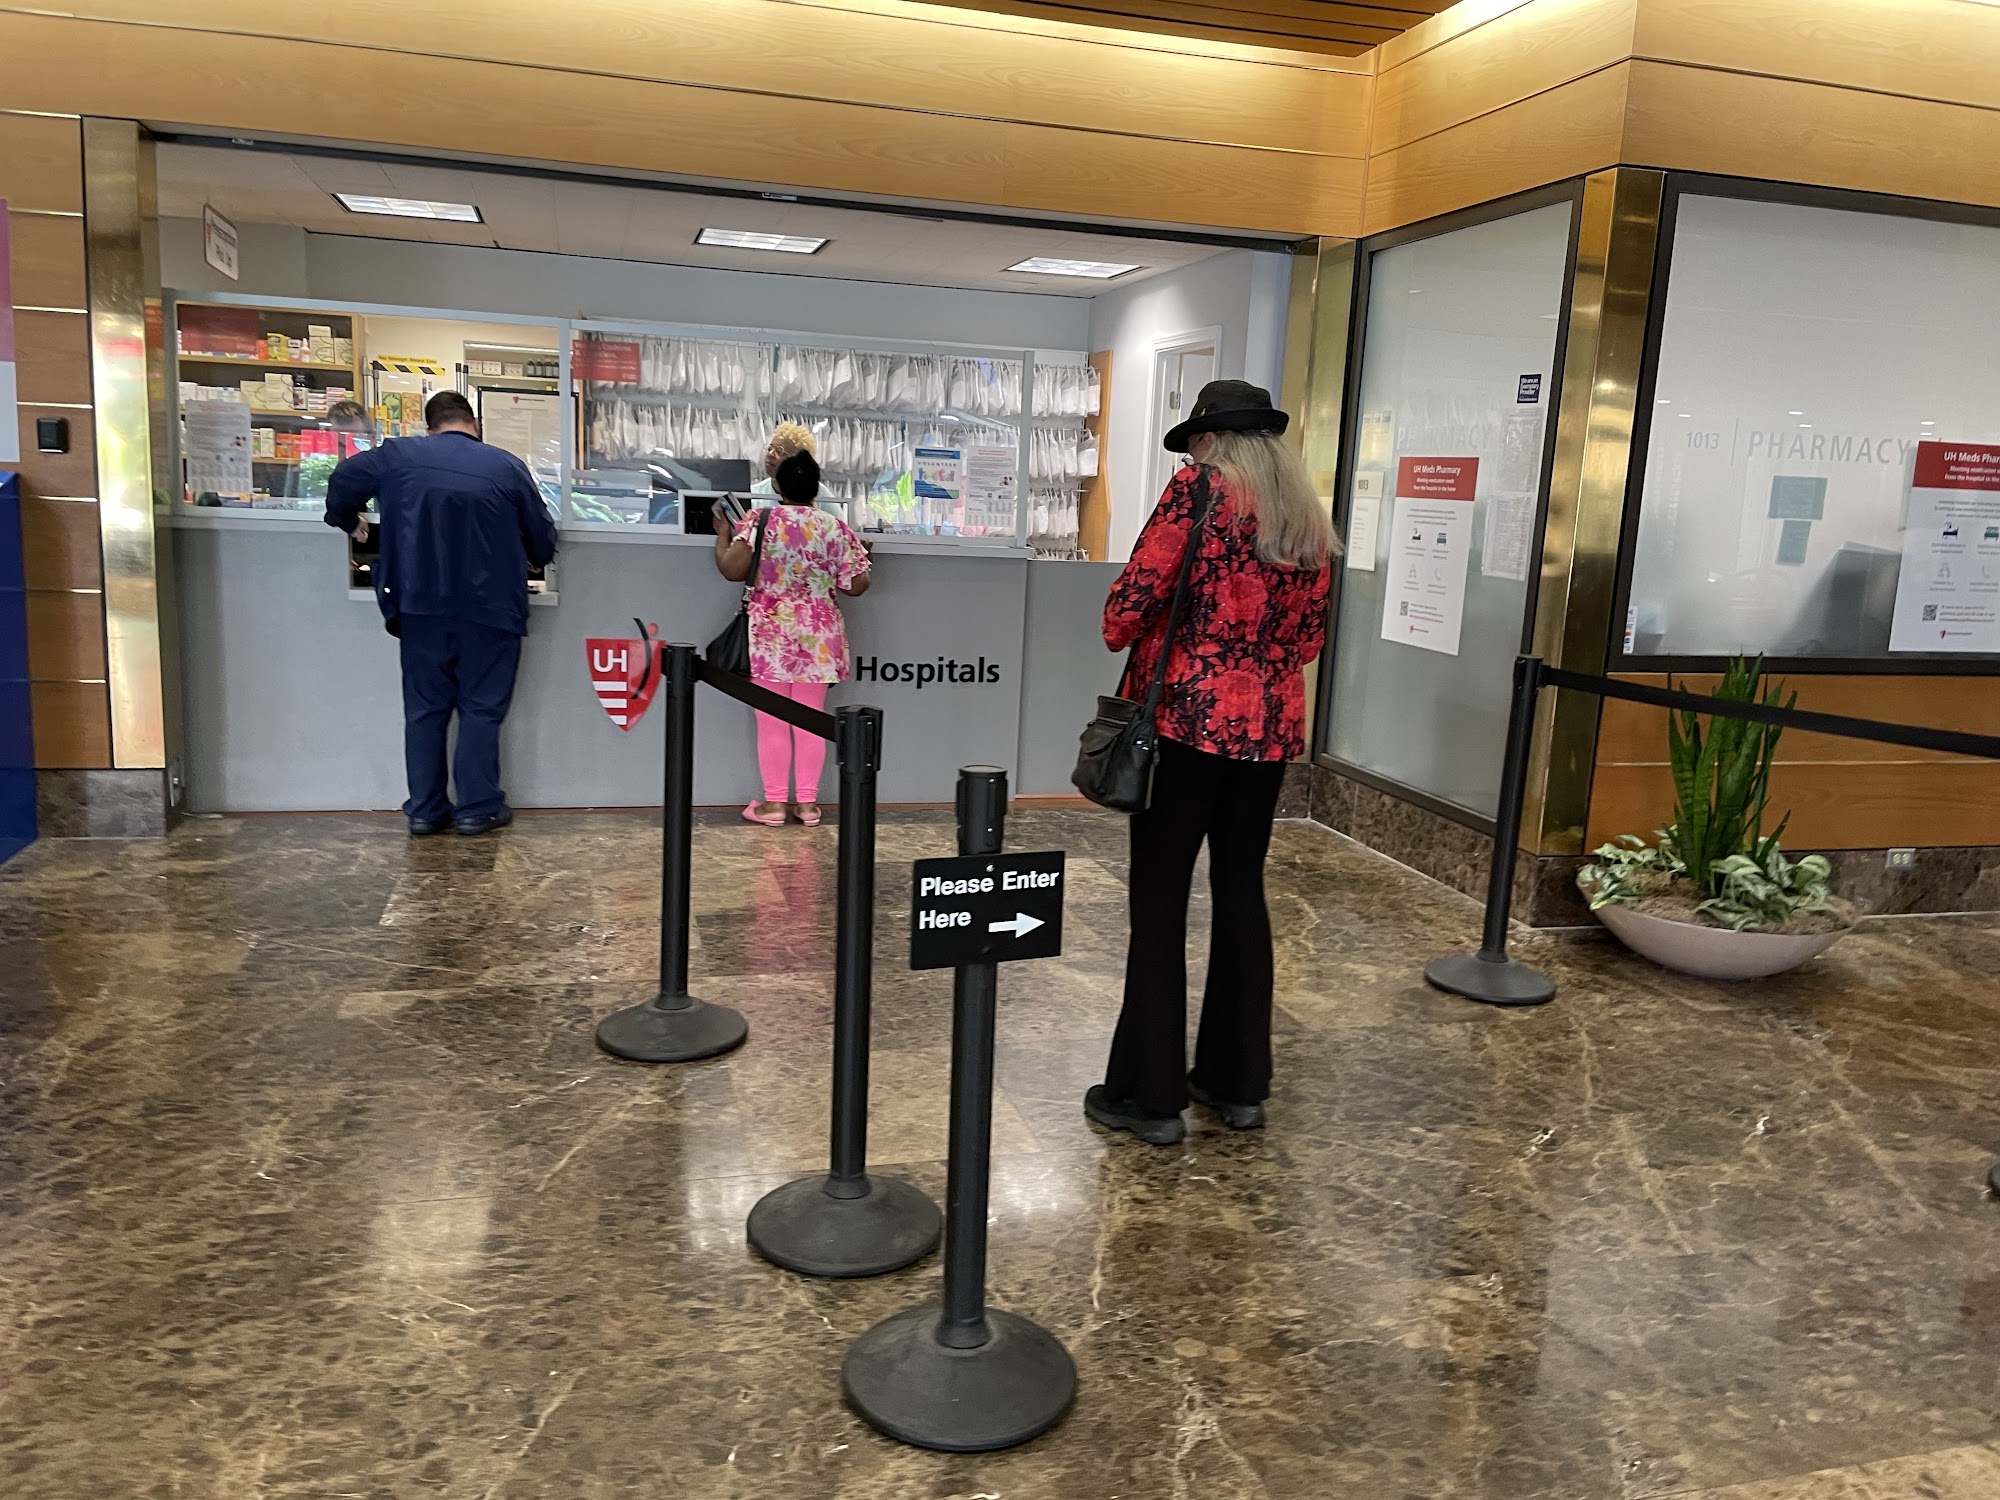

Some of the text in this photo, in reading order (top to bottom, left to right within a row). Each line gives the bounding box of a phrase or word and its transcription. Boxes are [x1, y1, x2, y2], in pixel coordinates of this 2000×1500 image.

[1686, 430, 1912, 465] 1013 PHARMACY
[1944, 450, 1957, 461] UH
[1958, 452, 1981, 462] Meds
[1413, 465, 1461, 476] UH Meds Pharmacy
[1357, 479, 1369, 490] 1013
[593, 648, 628, 673] UH
[855, 656, 1000, 689] Hospitals
[920, 870, 1060, 897] Please Enter
[918, 909, 972, 930] Here
